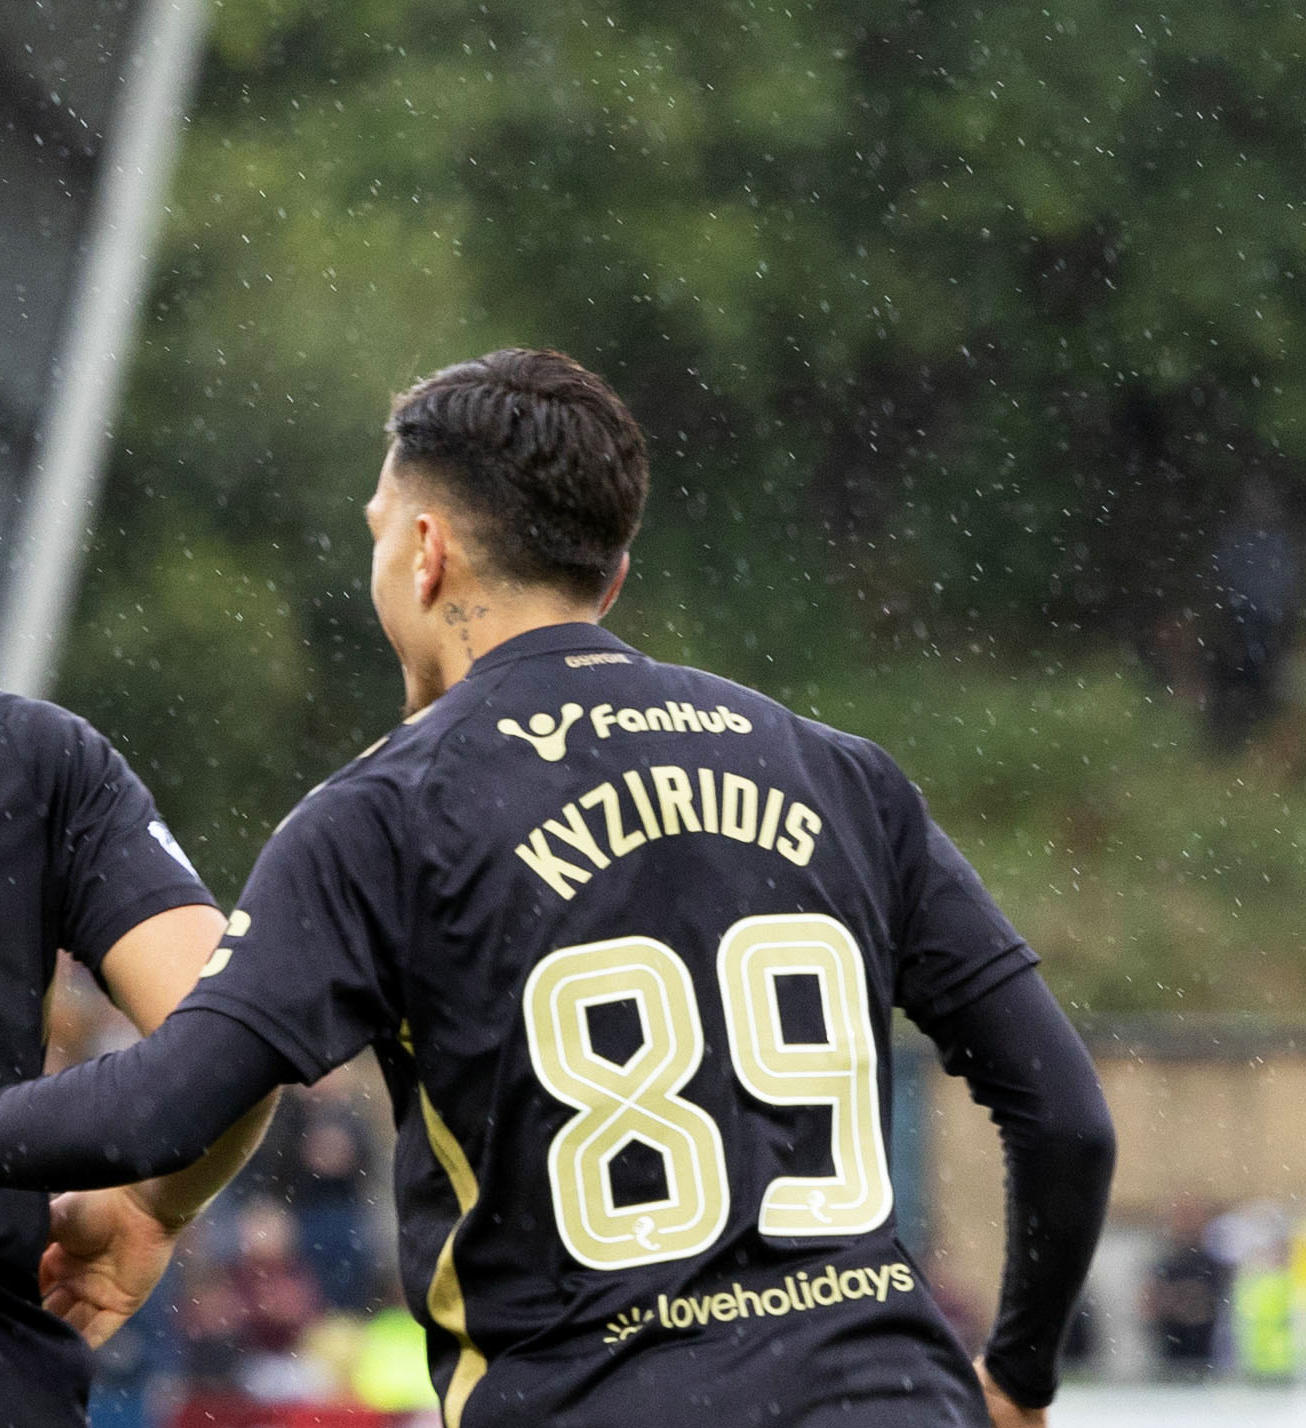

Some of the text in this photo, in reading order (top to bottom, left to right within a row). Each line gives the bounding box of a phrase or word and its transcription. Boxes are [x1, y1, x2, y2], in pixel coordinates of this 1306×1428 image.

[515, 765, 822, 900] KYZIRIDIS
[523, 913, 893, 1270] 89
[657, 1262, 915, 1328] loveholidays
